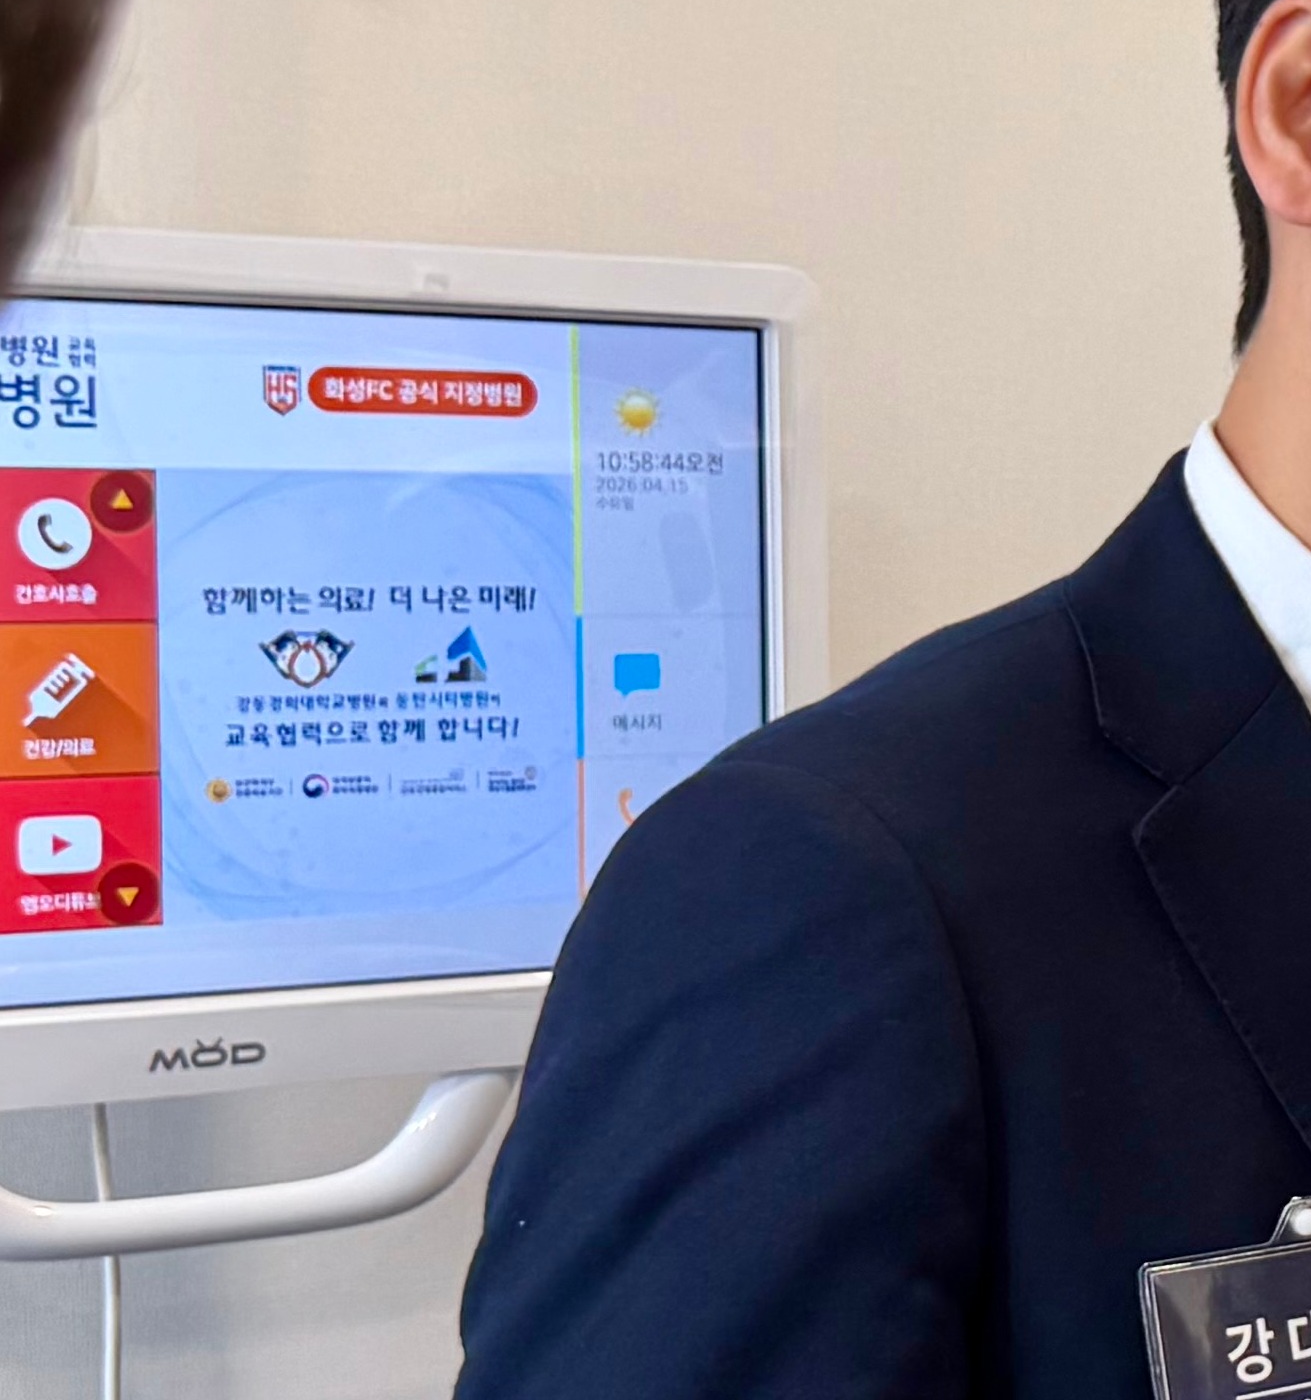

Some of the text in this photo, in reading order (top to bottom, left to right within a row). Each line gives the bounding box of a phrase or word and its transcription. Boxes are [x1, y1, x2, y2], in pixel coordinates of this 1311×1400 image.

[0, 336, 60, 368] 병원
[0, 374, 97, 430] 병원
[325, 377, 522, 408] 화성FC 공식 지정병원
[203, 586, 313, 615] 함께하는
[389, 585, 413, 614] 더
[421, 585, 472, 614] 나은
[225, 720, 372, 748] 교육협력으로
[378, 718, 426, 744] 함께
